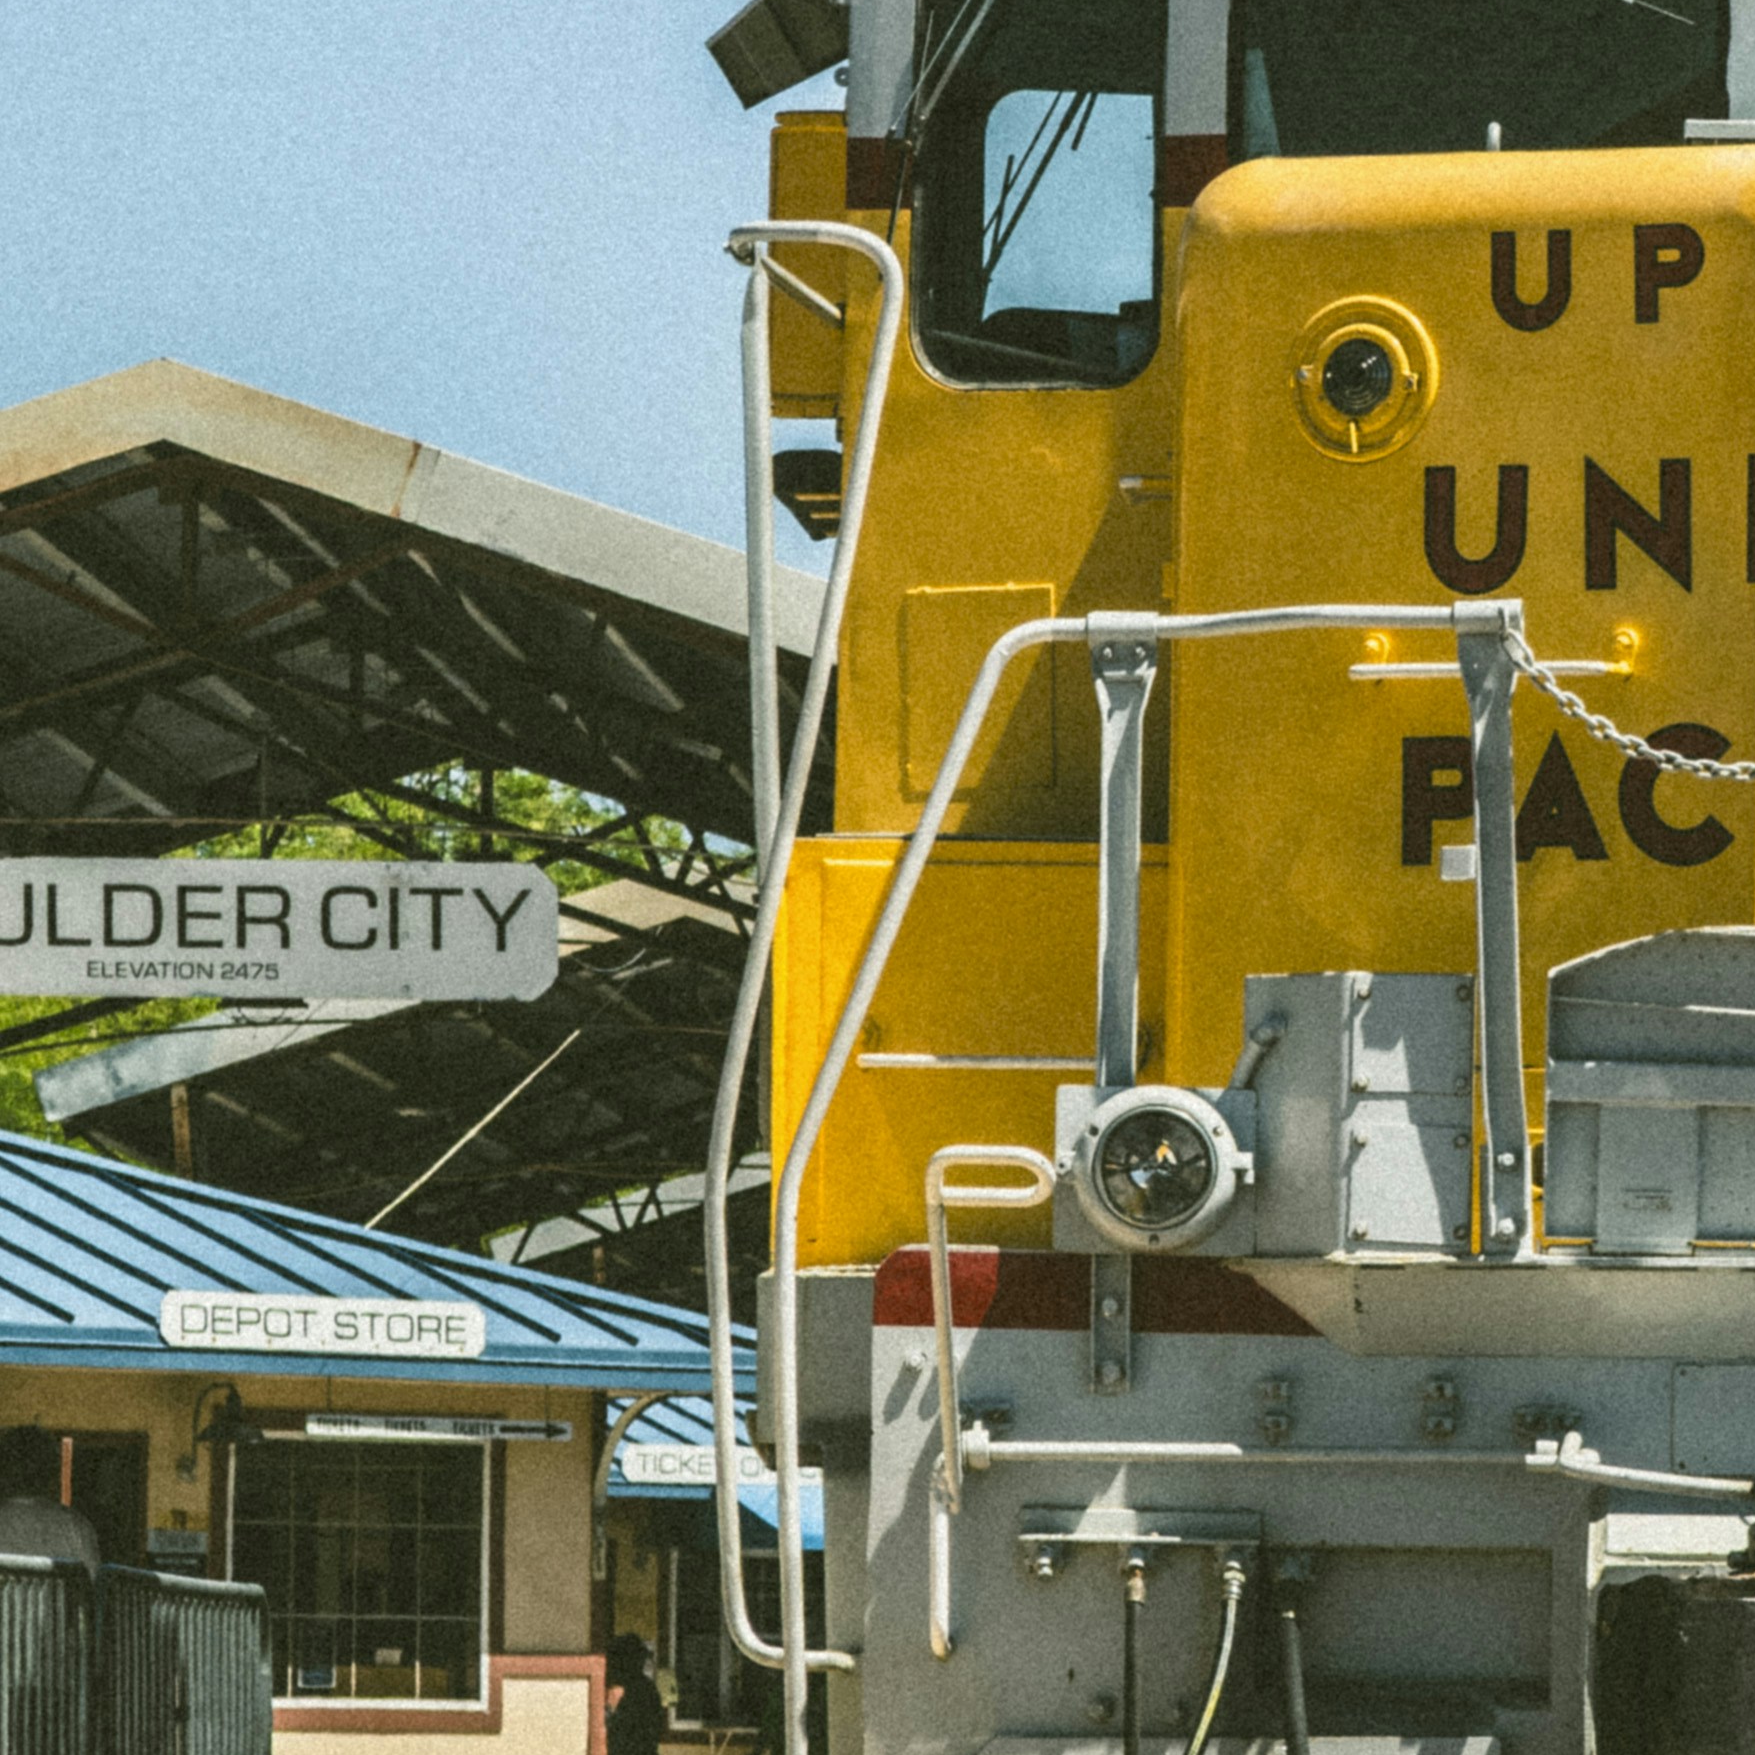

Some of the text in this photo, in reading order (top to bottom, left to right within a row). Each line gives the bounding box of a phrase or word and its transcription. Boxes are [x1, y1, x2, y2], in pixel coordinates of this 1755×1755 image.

[1489, 223, 1706, 332] UP
[319, 885, 533, 952] CITY
[86, 960, 280, 980] ELEVATION 2475
[180, 1303, 467, 1345] DEPOT STORE
[636, 1451, 713, 1476] TICKE
